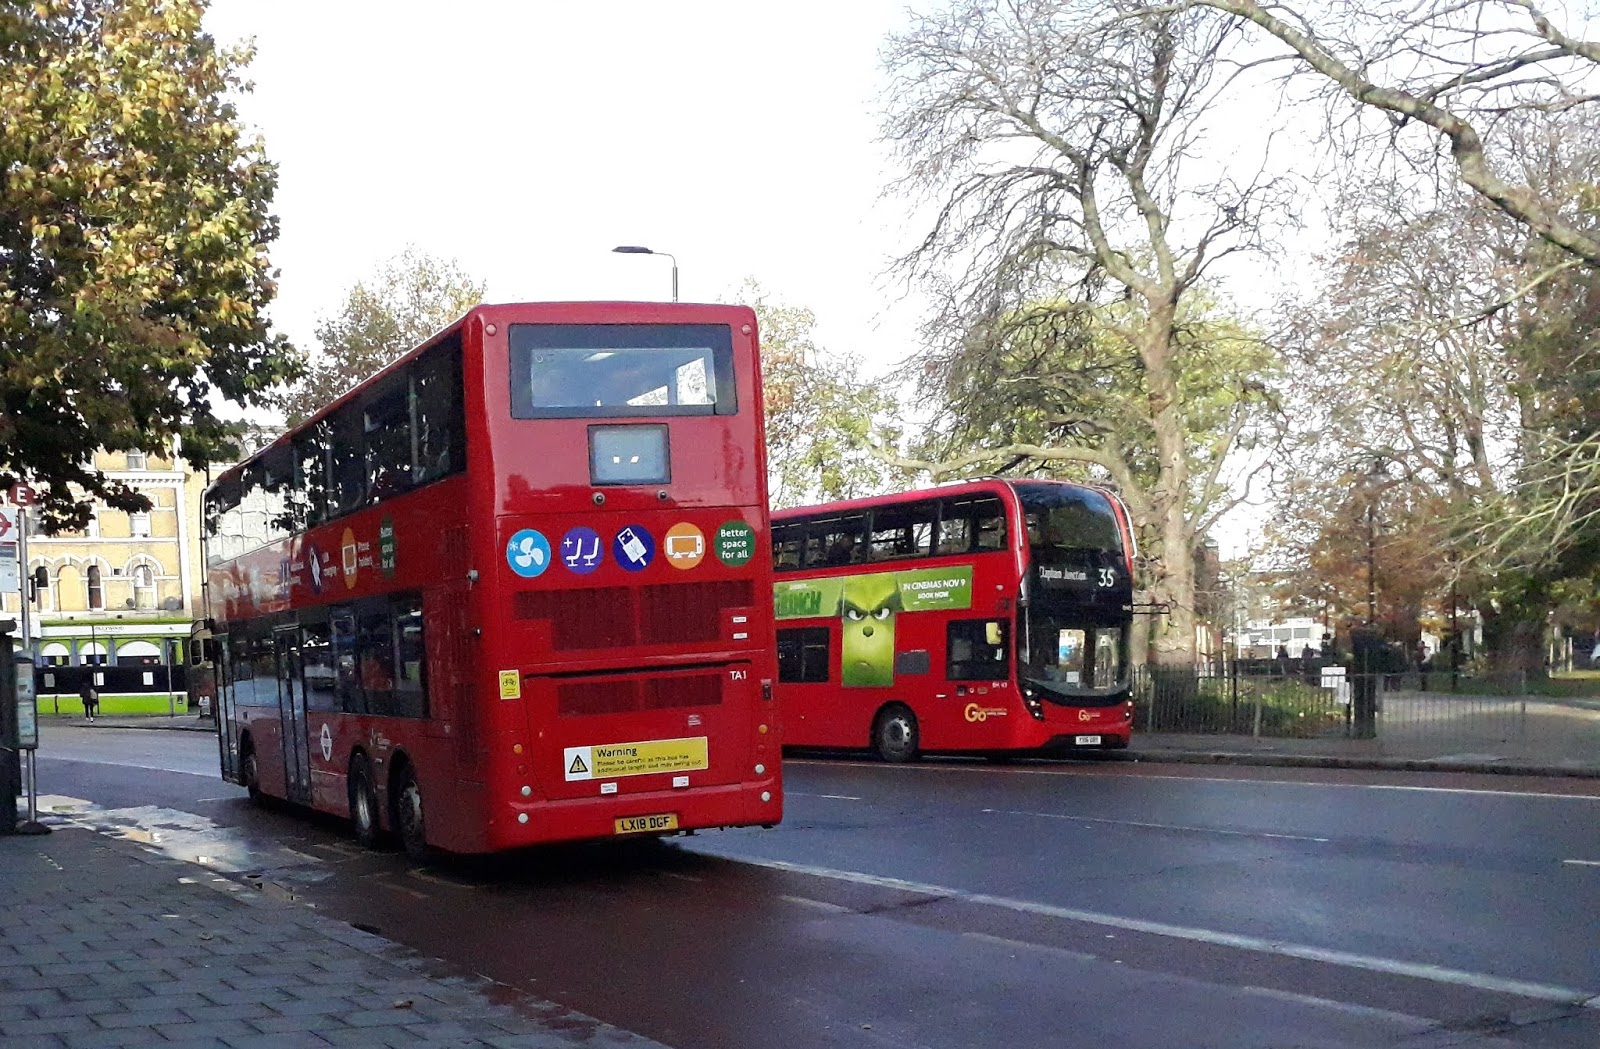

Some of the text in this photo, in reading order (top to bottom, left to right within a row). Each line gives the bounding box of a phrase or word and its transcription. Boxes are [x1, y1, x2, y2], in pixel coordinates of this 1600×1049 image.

[16, 486, 28, 503] E
[720, 529, 748, 537] Better
[722, 540, 747, 549] space
[721, 549, 748, 559] for all
[1098, 567, 1115, 588] 35
[903, 578, 966, 591] IN CINEMAS NOV 9
[729, 670, 747, 681] TA1
[964, 702, 988, 722] Go
[1078, 709, 1091, 721] Go
[597, 747, 638, 758] Warning
[649, 815, 671, 829] DGF
